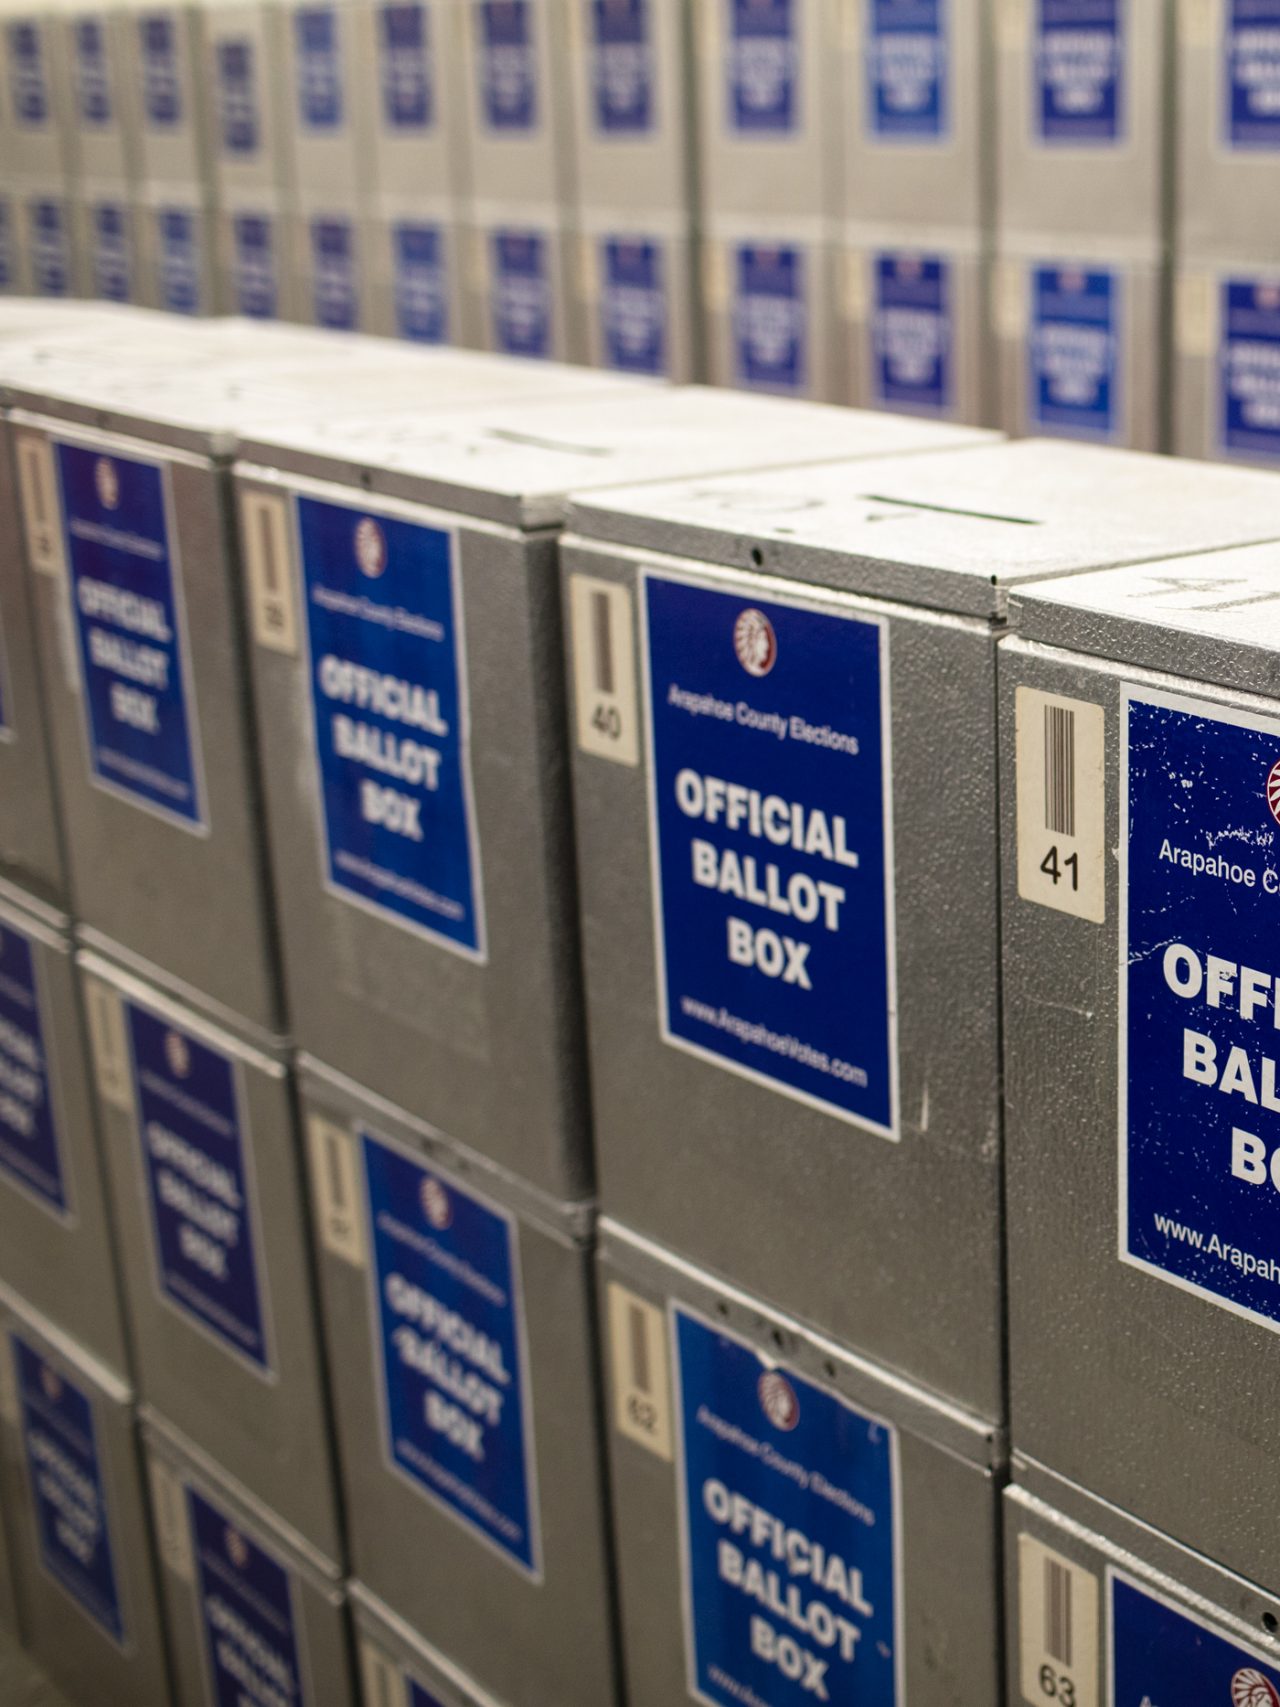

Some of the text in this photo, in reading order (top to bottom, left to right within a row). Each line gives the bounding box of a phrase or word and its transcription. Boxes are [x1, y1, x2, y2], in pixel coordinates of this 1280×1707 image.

[319, 654, 448, 736] OFFICIAL
[590, 705, 620, 741] 40
[668, 684, 858, 755] Arapahoe County Elections
[332, 713, 442, 791] BALLOT
[360, 778, 423, 842] BOX
[675, 768, 859, 868] OFFICIAL
[691, 839, 844, 931] BALLOT
[1040, 846, 1080, 892] 41
[1159, 839, 1255, 889] Arapahoe
[727, 917, 812, 990] BOX
[681, 995, 867, 1088] www.ArapahoeVotes.com
[702, 1477, 872, 1617] OFFICIAL
[718, 1539, 861, 1662] BALLOT
[750, 1615, 829, 1701] BOX
[1039, 1664, 1076, 1707] 63
